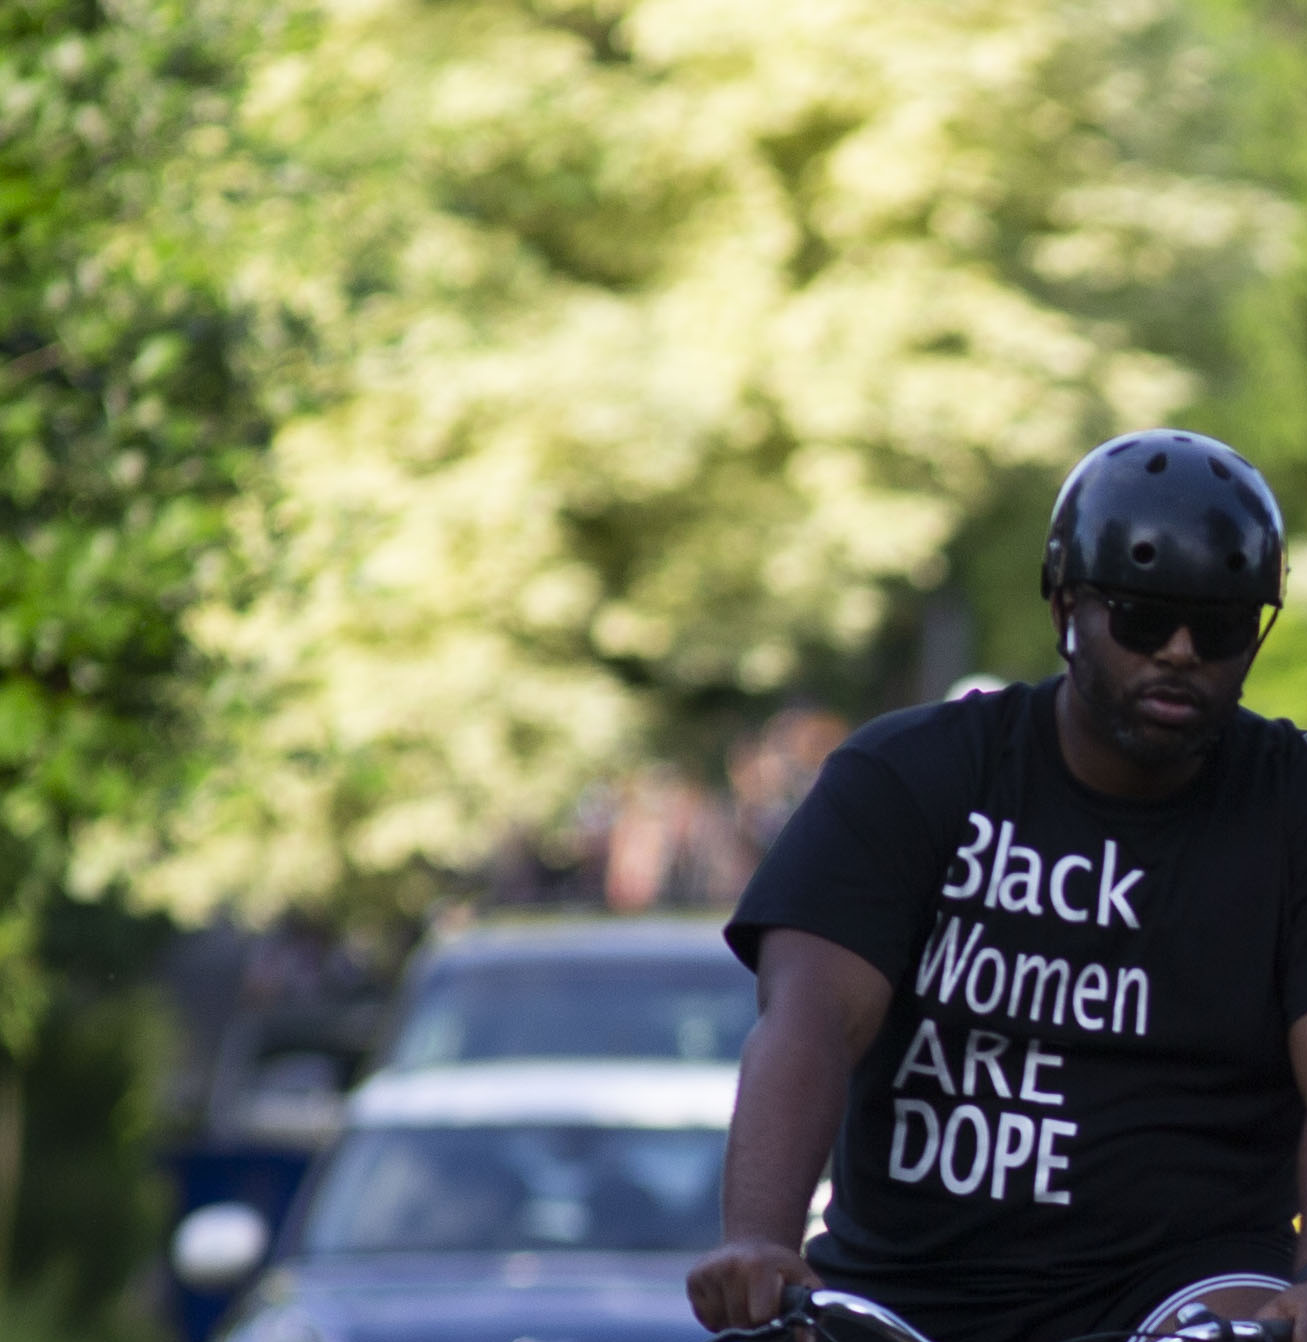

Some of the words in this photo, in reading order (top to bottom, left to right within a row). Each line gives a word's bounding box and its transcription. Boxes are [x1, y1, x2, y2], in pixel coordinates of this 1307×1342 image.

[942, 811, 1145, 930] Black
[914, 910, 1150, 1036] Women
[892, 1018, 1065, 1106] ARE
[888, 1097, 1079, 1206] DOPE
